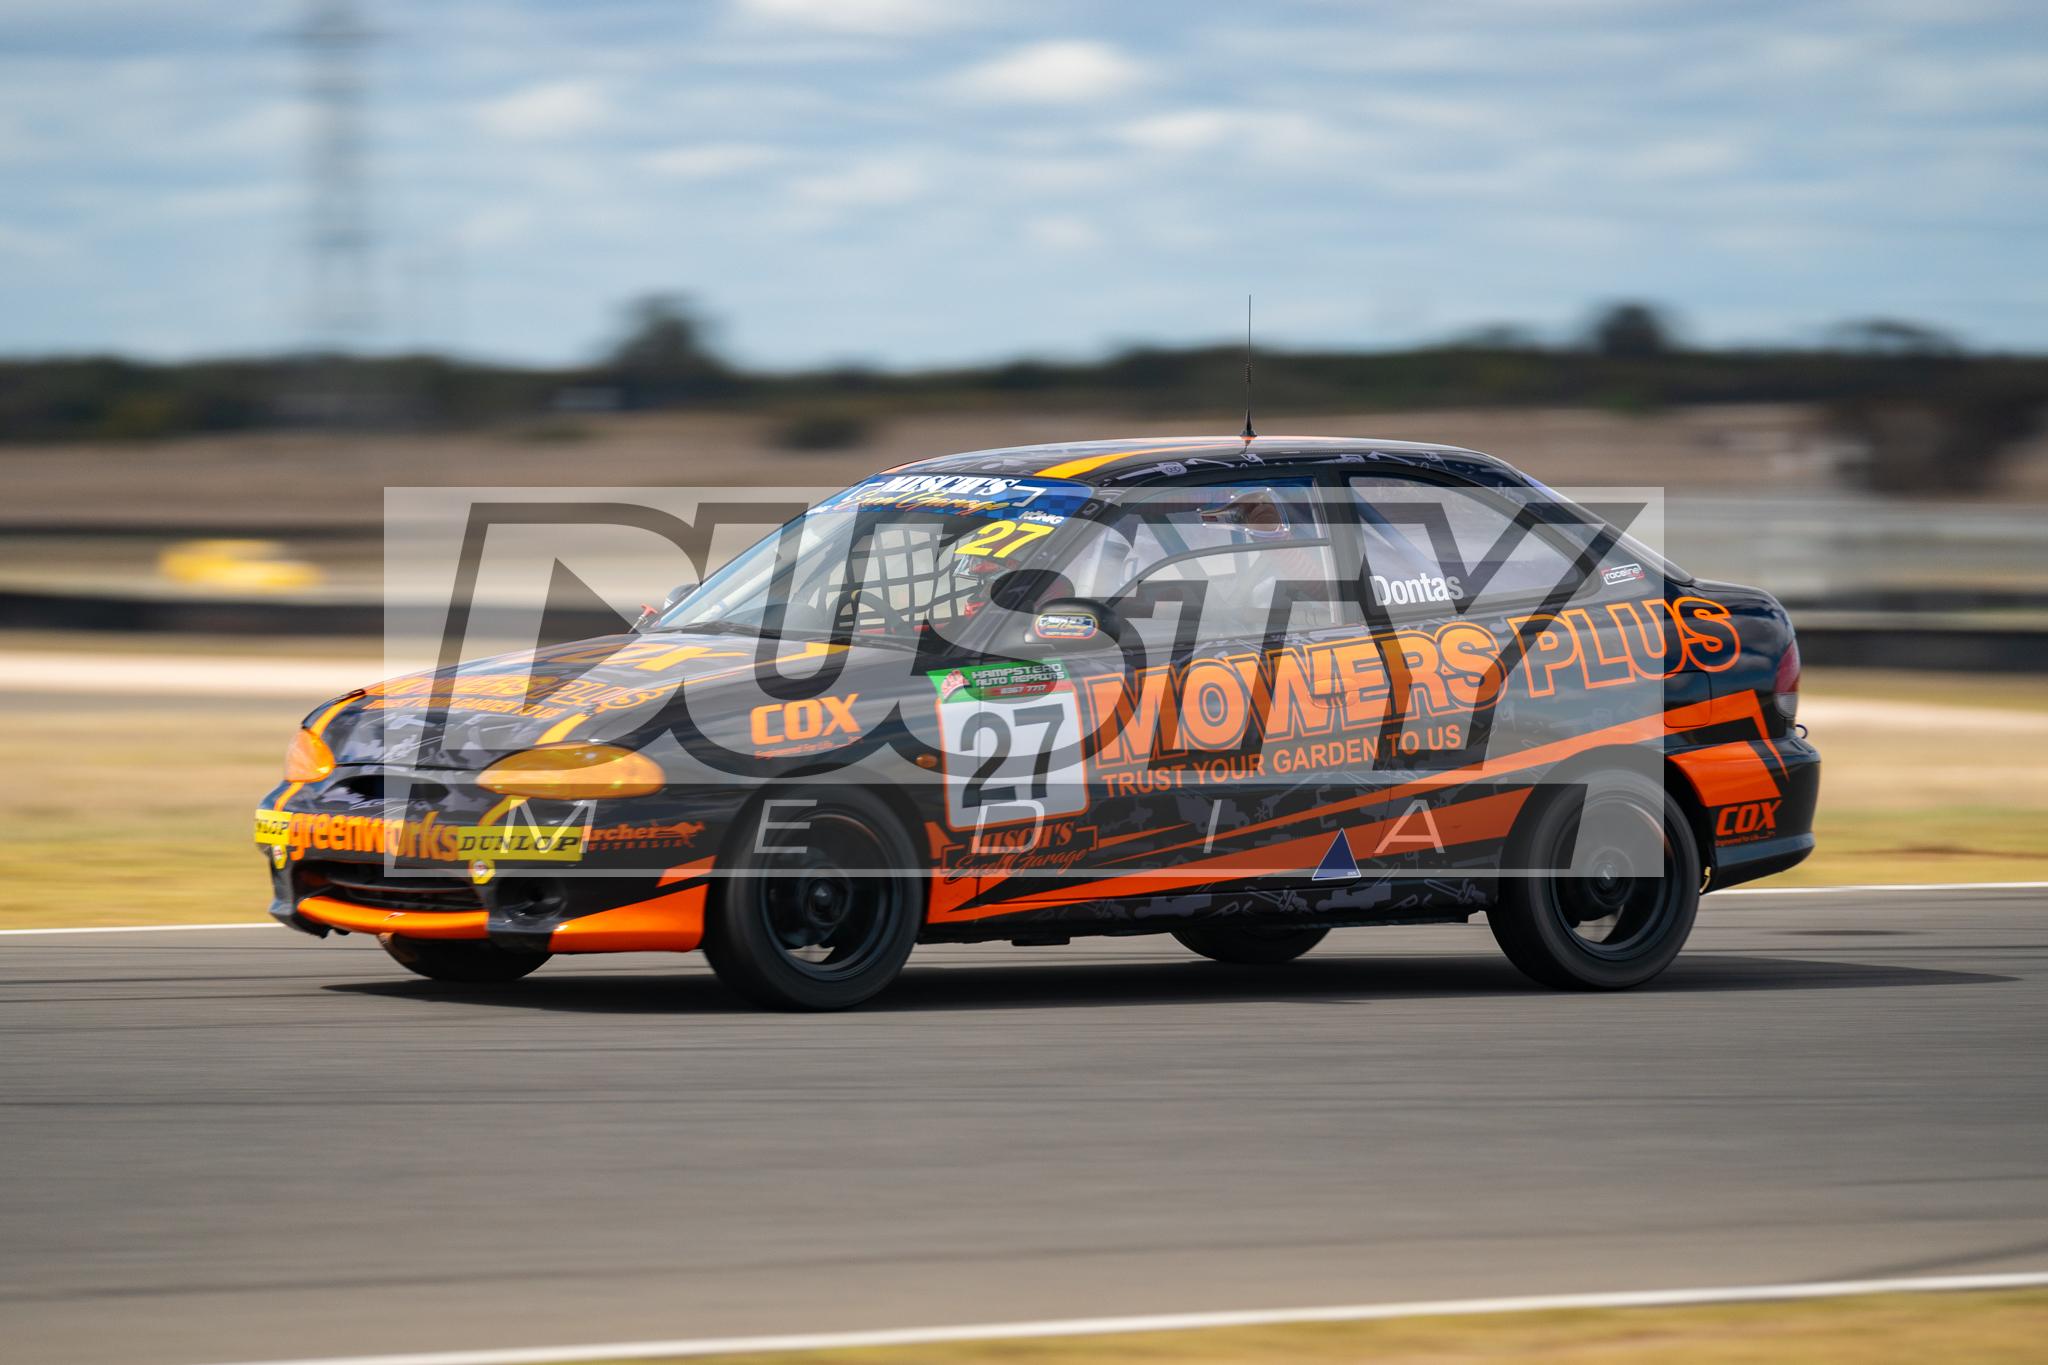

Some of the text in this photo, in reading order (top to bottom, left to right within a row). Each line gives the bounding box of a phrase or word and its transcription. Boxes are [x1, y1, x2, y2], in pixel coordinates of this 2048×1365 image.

[955, 520, 1055, 559] 27
[1369, 573, 1464, 606] Dontas
[971, 664, 1062, 679] HAMPSTEAD
[976, 677, 1008, 687] AUTO
[1011, 671, 1065, 684] REPAIRS
[1083, 597, 1741, 769] MOWERS PLUS
[750, 693, 862, 745] COX
[959, 703, 1065, 808] 27
[1101, 724, 1462, 798] TRUST YOUR GARDEN TO US
[289, 810, 459, 861] greenworks
[1716, 800, 1782, 836] COX
[460, 834, 580, 853] DUNLOP
